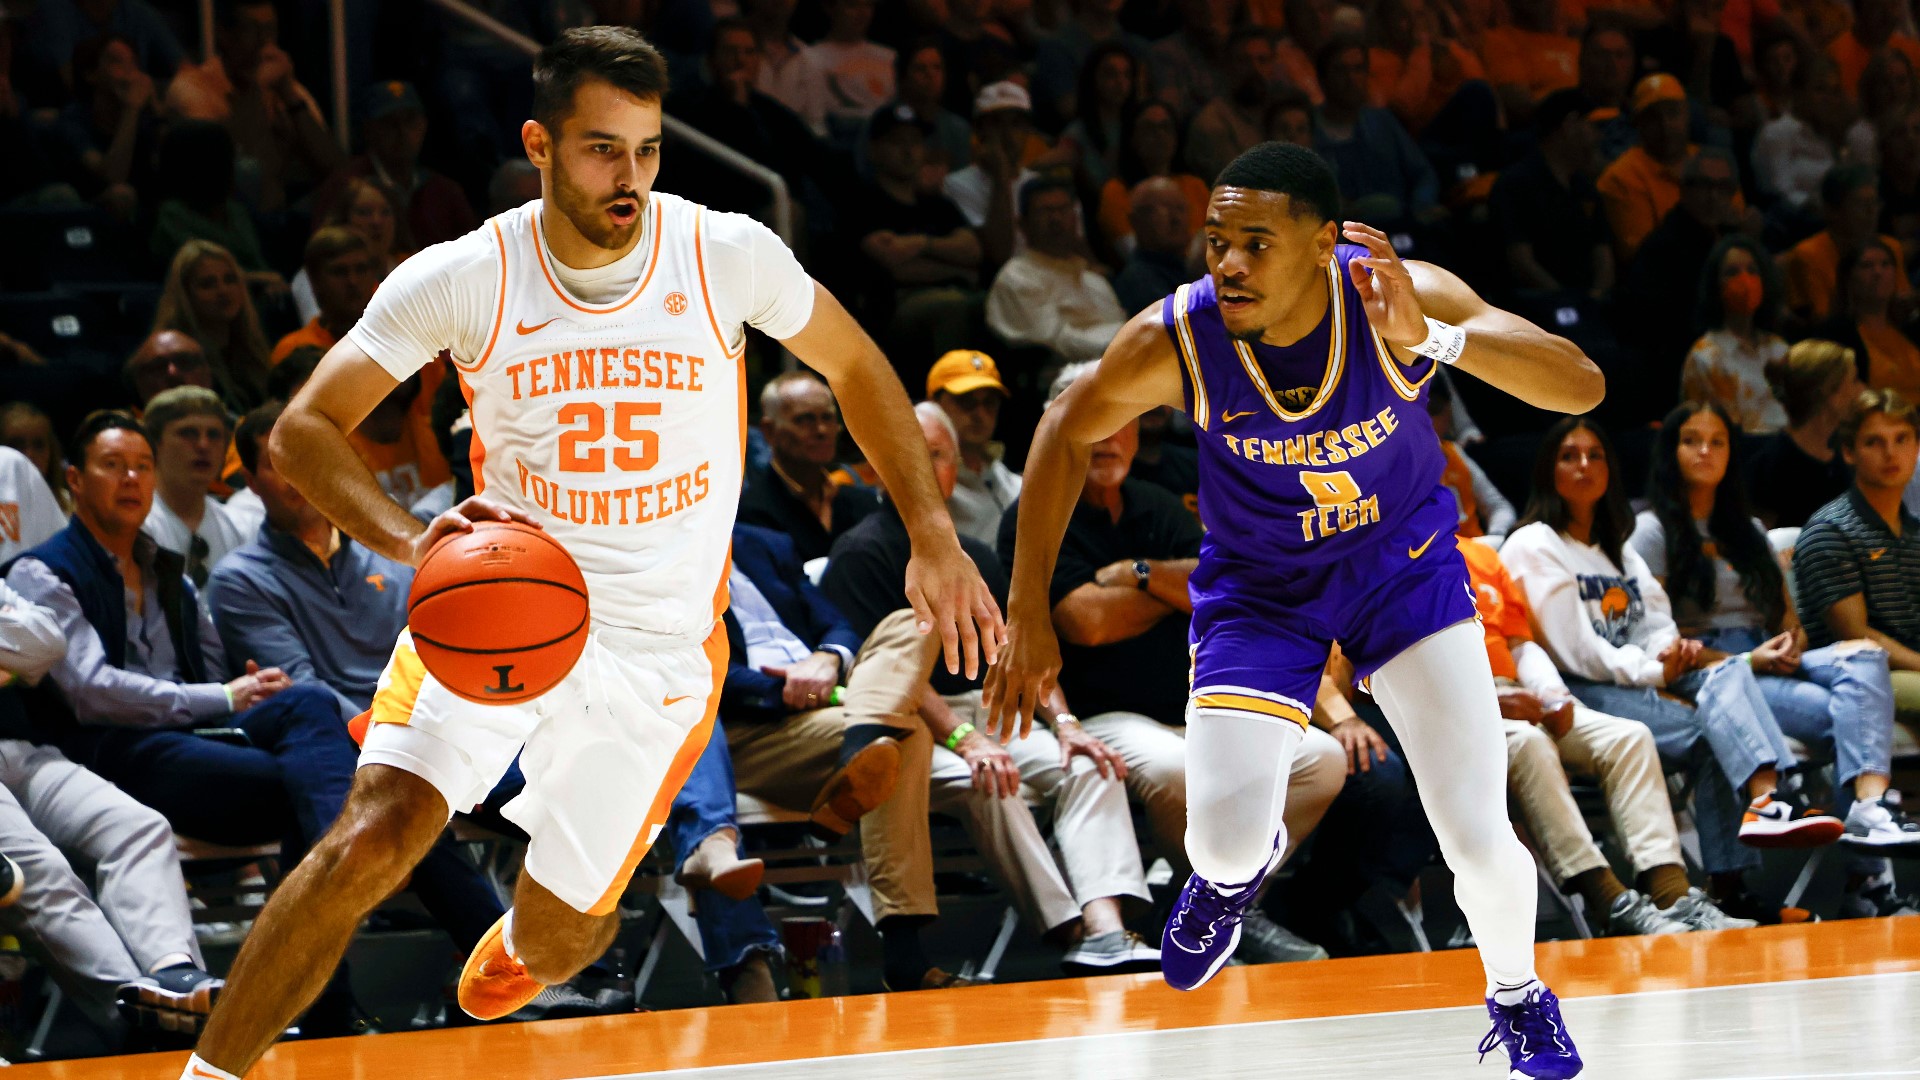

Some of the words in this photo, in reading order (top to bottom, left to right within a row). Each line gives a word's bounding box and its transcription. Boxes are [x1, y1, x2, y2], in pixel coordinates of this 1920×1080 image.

[666, 293, 685, 313] SEC
[506, 348, 705, 400] TENNESSEE
[558, 402, 661, 472] 25
[1222, 405, 1399, 466] TENNESSEE
[516, 457, 709, 525] VOLUNTEERS
[1297, 493, 1380, 542] TECH
